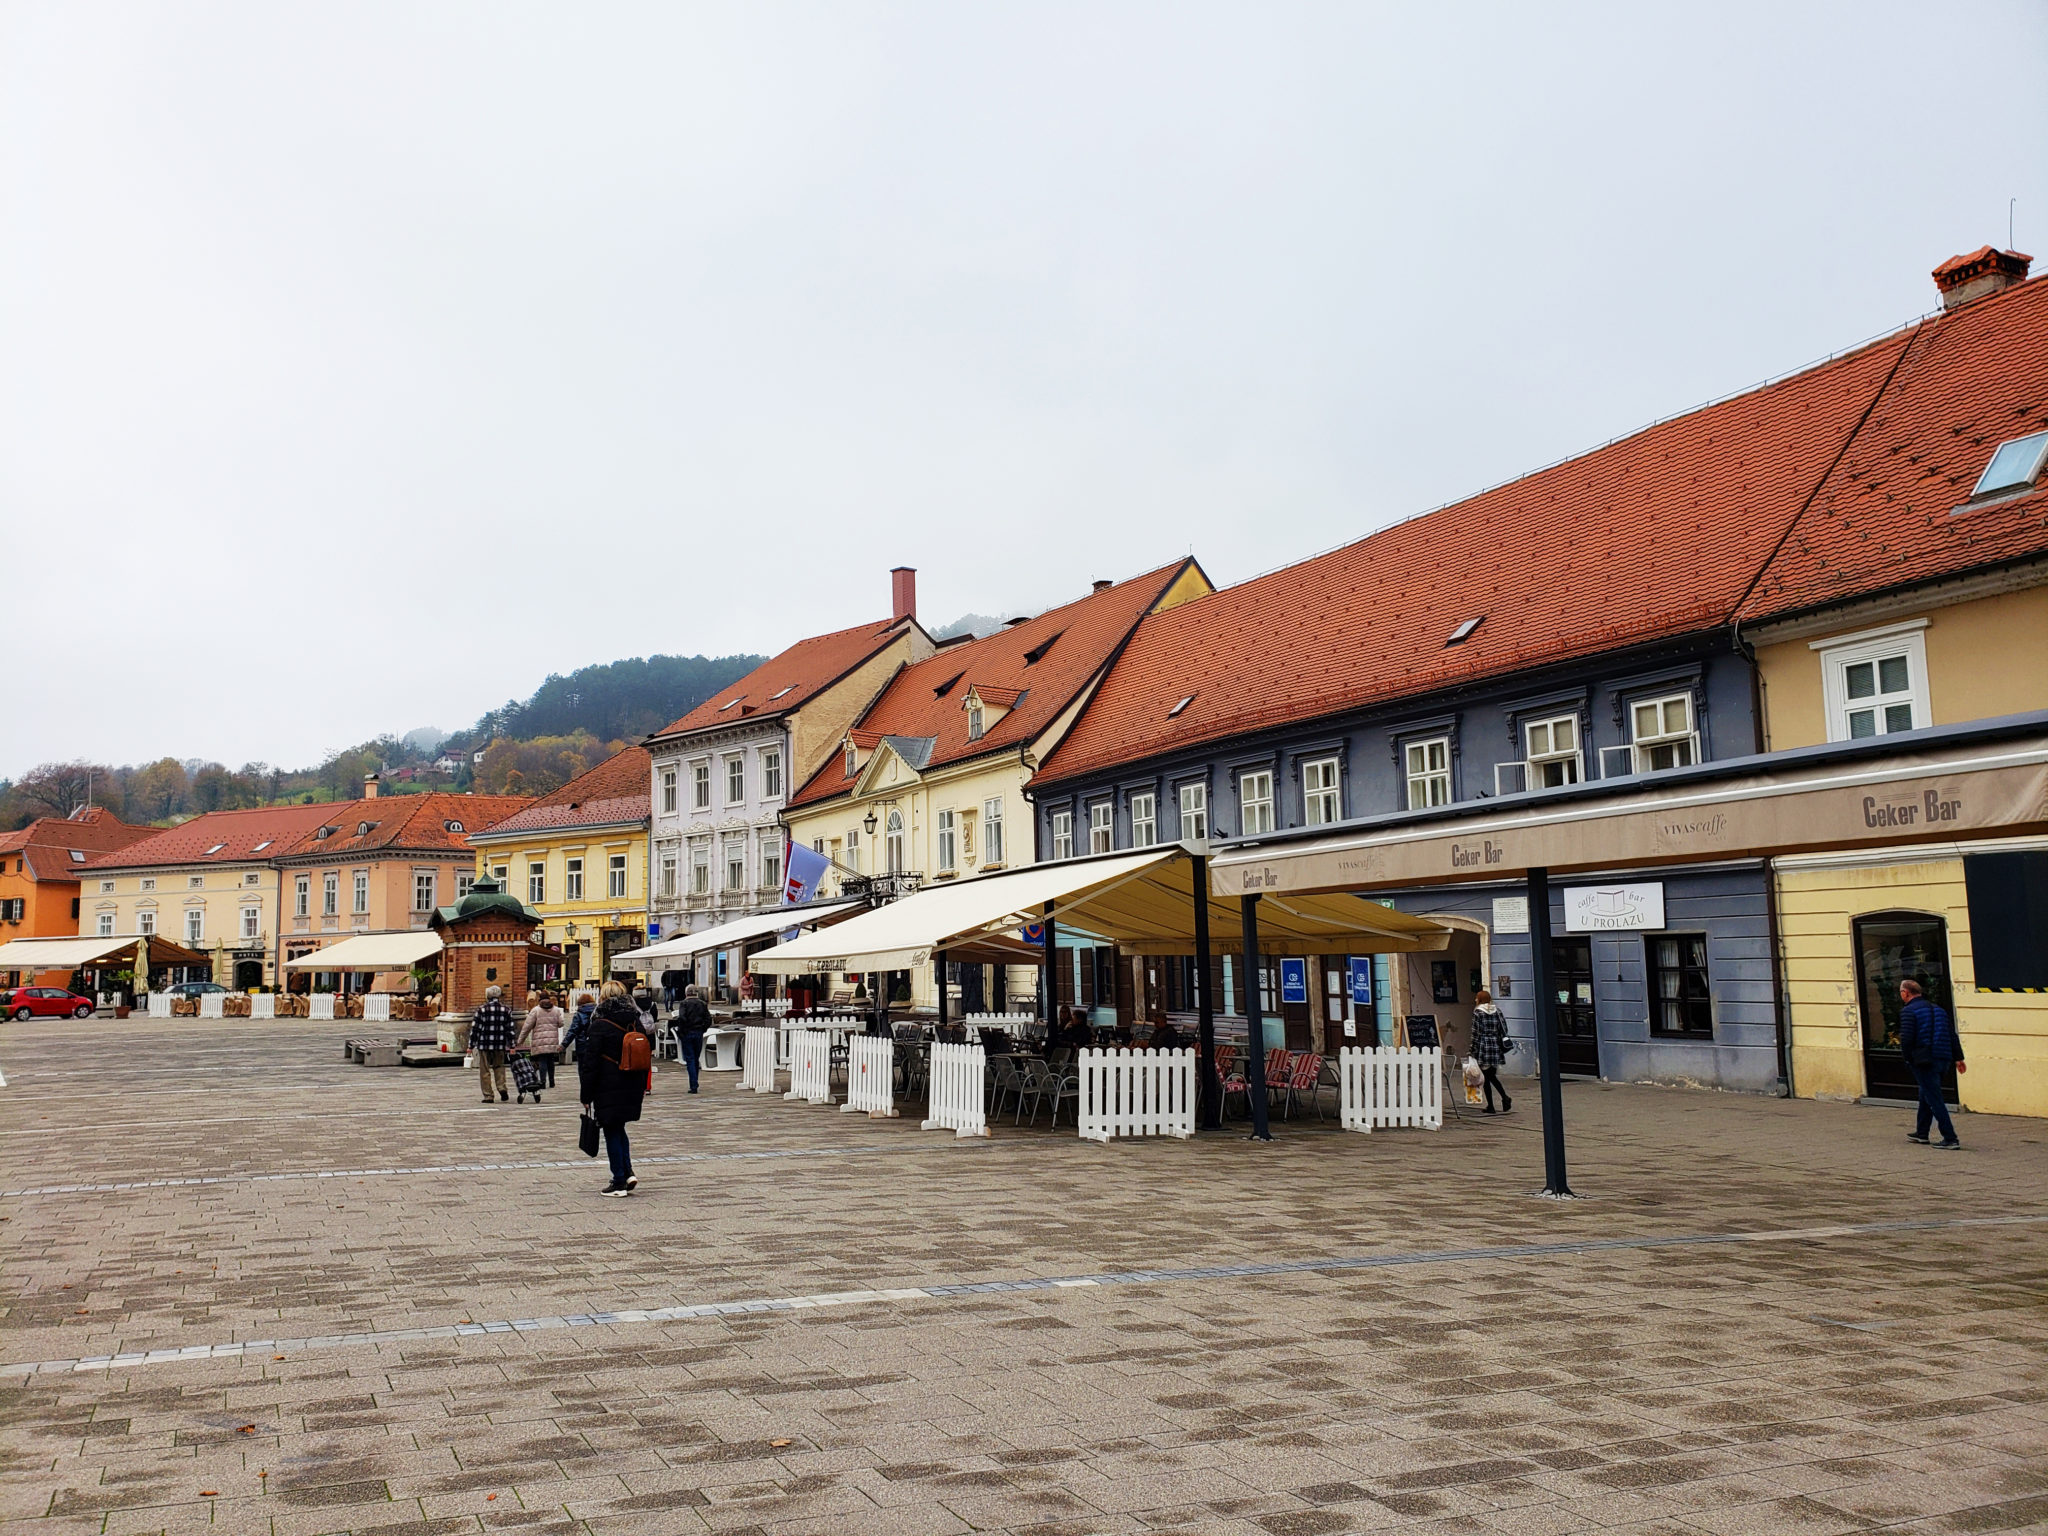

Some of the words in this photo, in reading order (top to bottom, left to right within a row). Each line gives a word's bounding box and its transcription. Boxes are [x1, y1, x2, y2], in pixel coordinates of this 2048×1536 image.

[1863, 796, 1918, 828] Ceker
[1923, 789, 1961, 822] Bar
[1451, 844, 1480, 867] Ceker
[1484, 840, 1502, 864] Bar
[1243, 870, 1262, 888] Ceker
[1264, 867, 1277, 886] Bar
[1578, 894, 1595, 908] caffe
[1628, 891, 1645, 903] bar
[1581, 916, 1588, 926] U
[1594, 913, 1645, 928] PROLAZU
